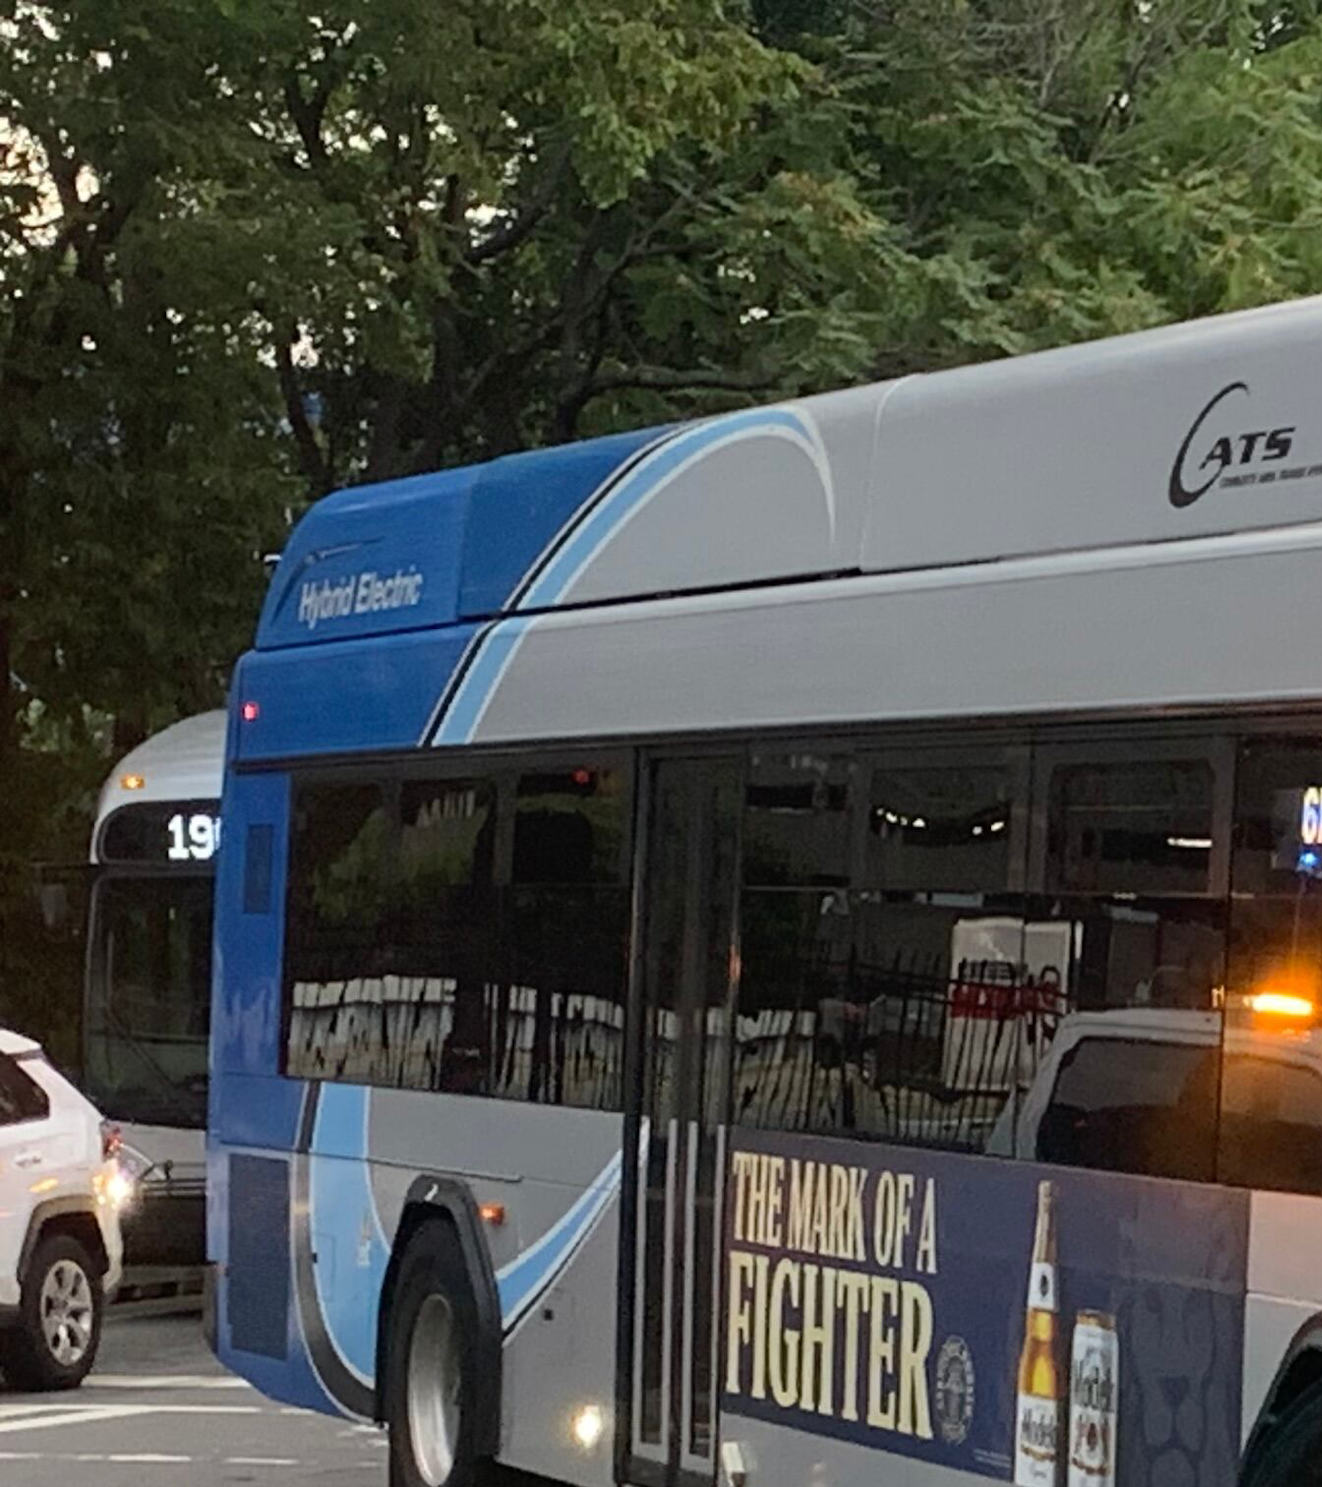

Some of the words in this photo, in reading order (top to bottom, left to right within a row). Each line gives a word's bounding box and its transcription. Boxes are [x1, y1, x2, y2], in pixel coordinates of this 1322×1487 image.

[298, 575, 356, 630] Hybrid
[354, 564, 423, 613] Electric
[732, 1151, 786, 1248] THE
[787, 1158, 868, 1262] MARK
[874, 1169, 914, 1269] OF
[916, 1177, 938, 1275] A
[725, 1250, 934, 1440] FIGHTER
